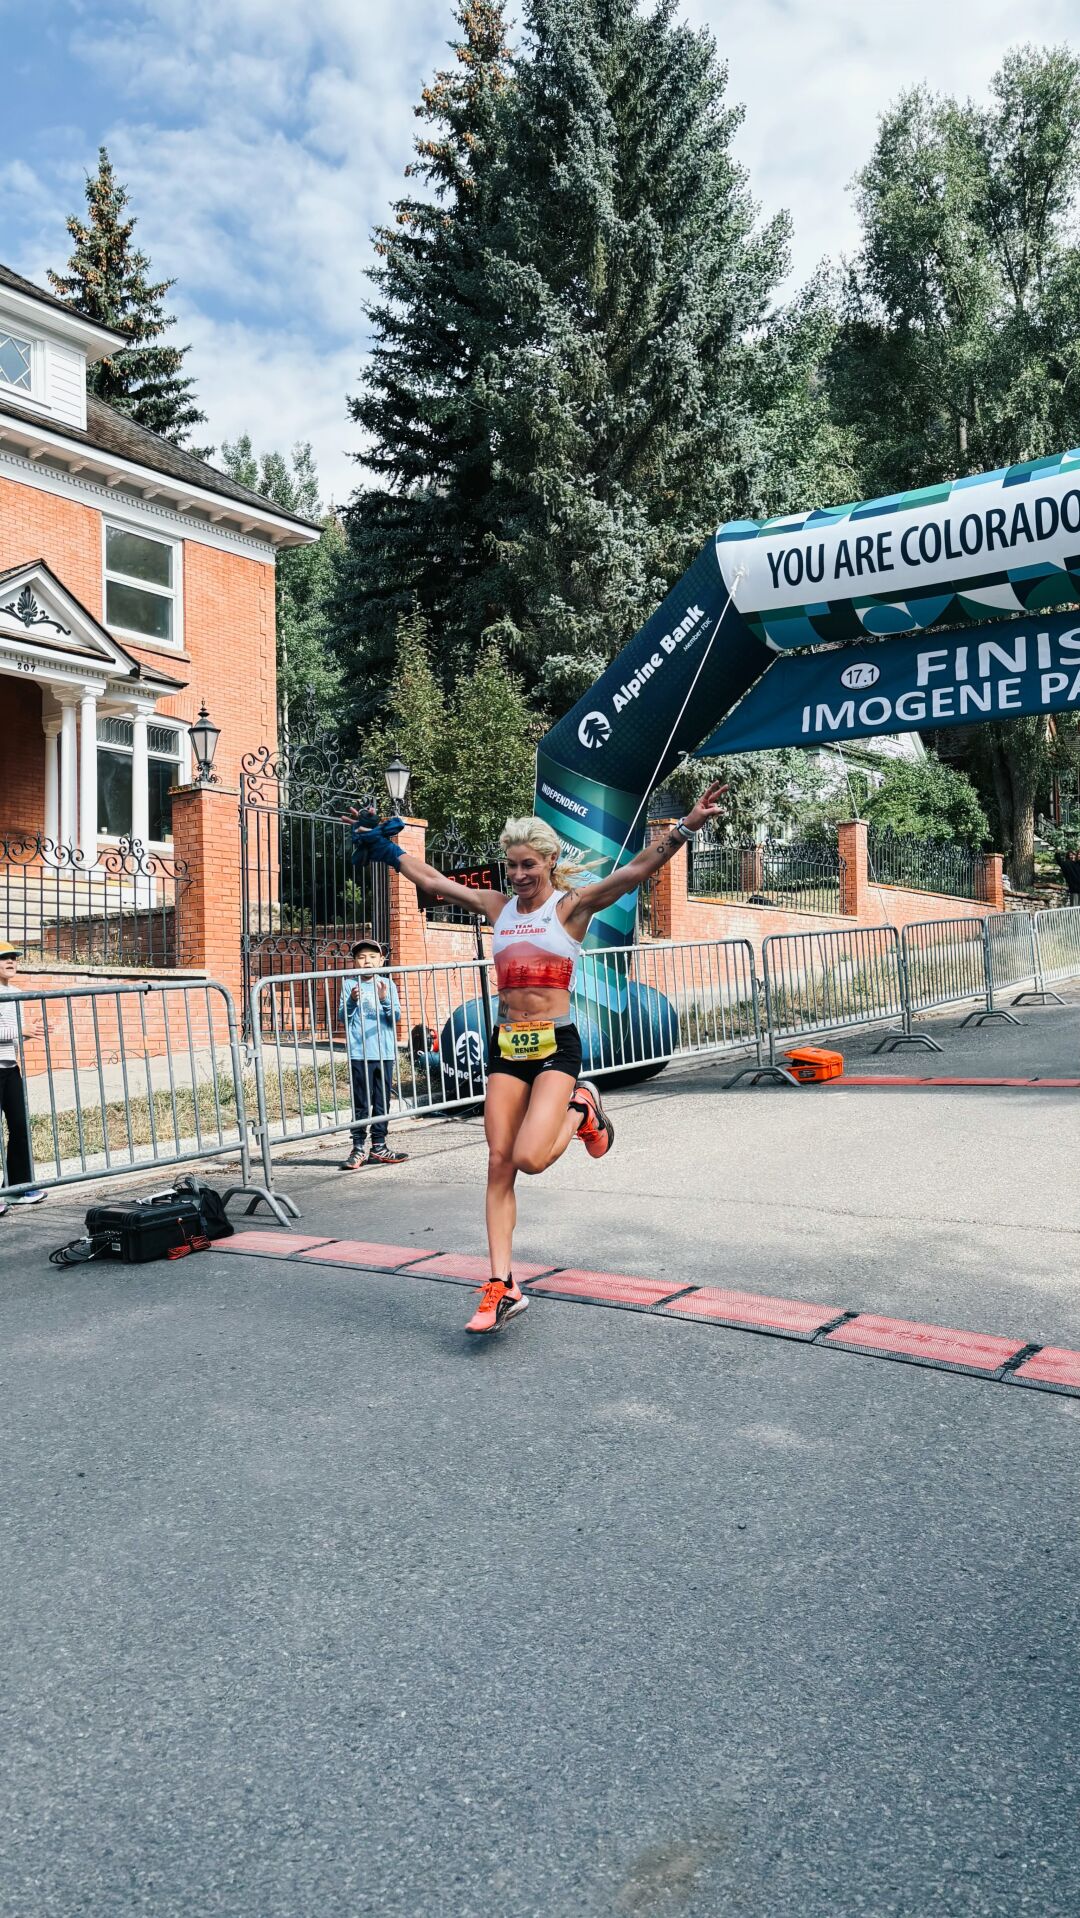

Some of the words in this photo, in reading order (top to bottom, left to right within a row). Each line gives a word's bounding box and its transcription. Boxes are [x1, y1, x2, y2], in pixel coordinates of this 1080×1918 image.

[767, 543, 824, 589] YOU
[834, 531, 894, 580] ARE
[900, 489, 1080, 567] COLORADO
[17, 662, 36, 673] 207
[611, 651, 664, 714] Alpine
[659, 604, 705, 655] Bank
[846, 667, 875, 685] 17.1
[801, 677, 1022, 734] IMOGENE
[541, 782, 589, 818] INDEPENDENCE
[511, 1032, 540, 1047] 493
[442, 1062, 470, 1080] Alpne
